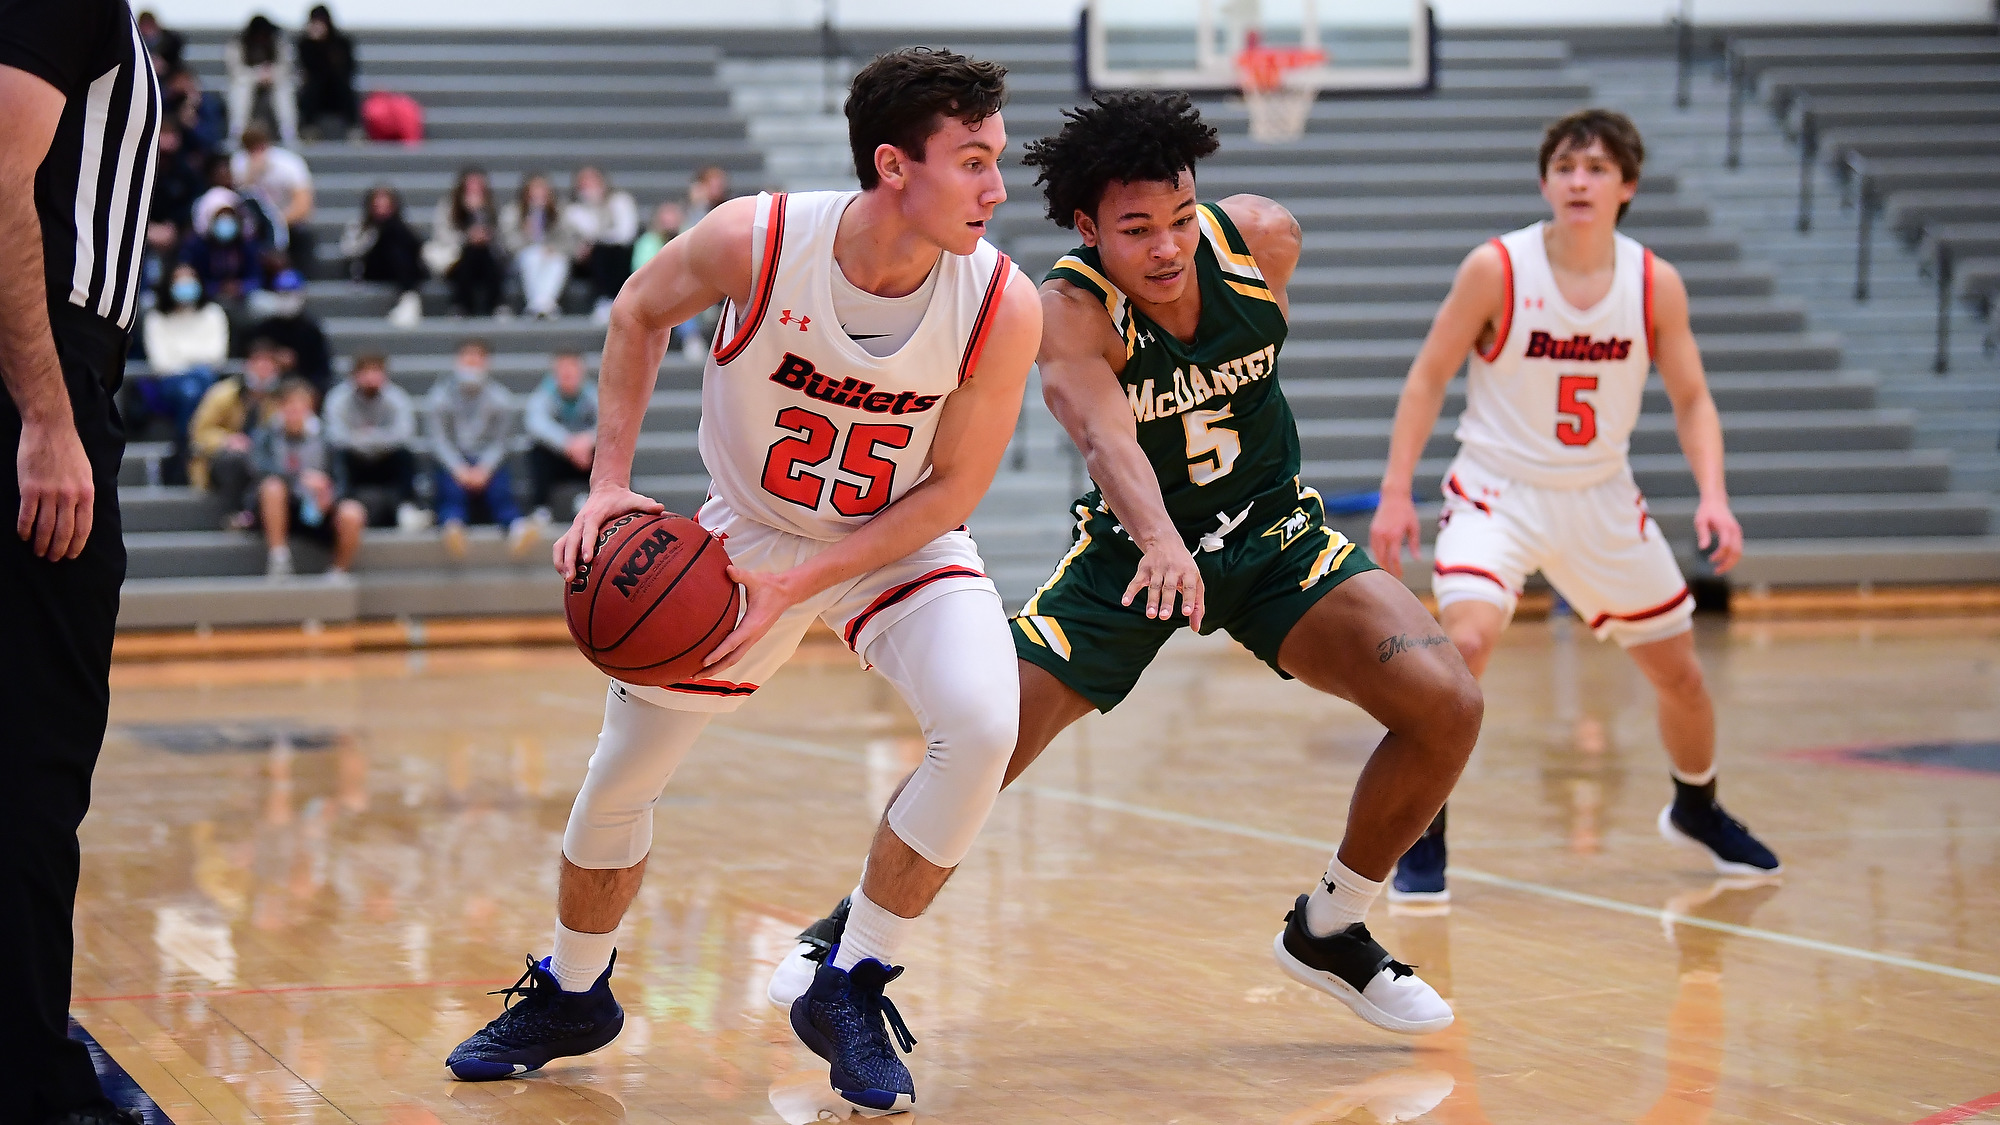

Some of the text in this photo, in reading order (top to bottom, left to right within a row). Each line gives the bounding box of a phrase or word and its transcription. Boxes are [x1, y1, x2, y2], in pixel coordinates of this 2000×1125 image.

[1525, 331, 1632, 361] Bullets
[769, 352, 943, 415] Bullets
[1556, 375, 1598, 446] 5
[761, 406, 914, 516] 25
[1181, 402, 1241, 486] 5
[611, 528, 678, 598] NCAA
